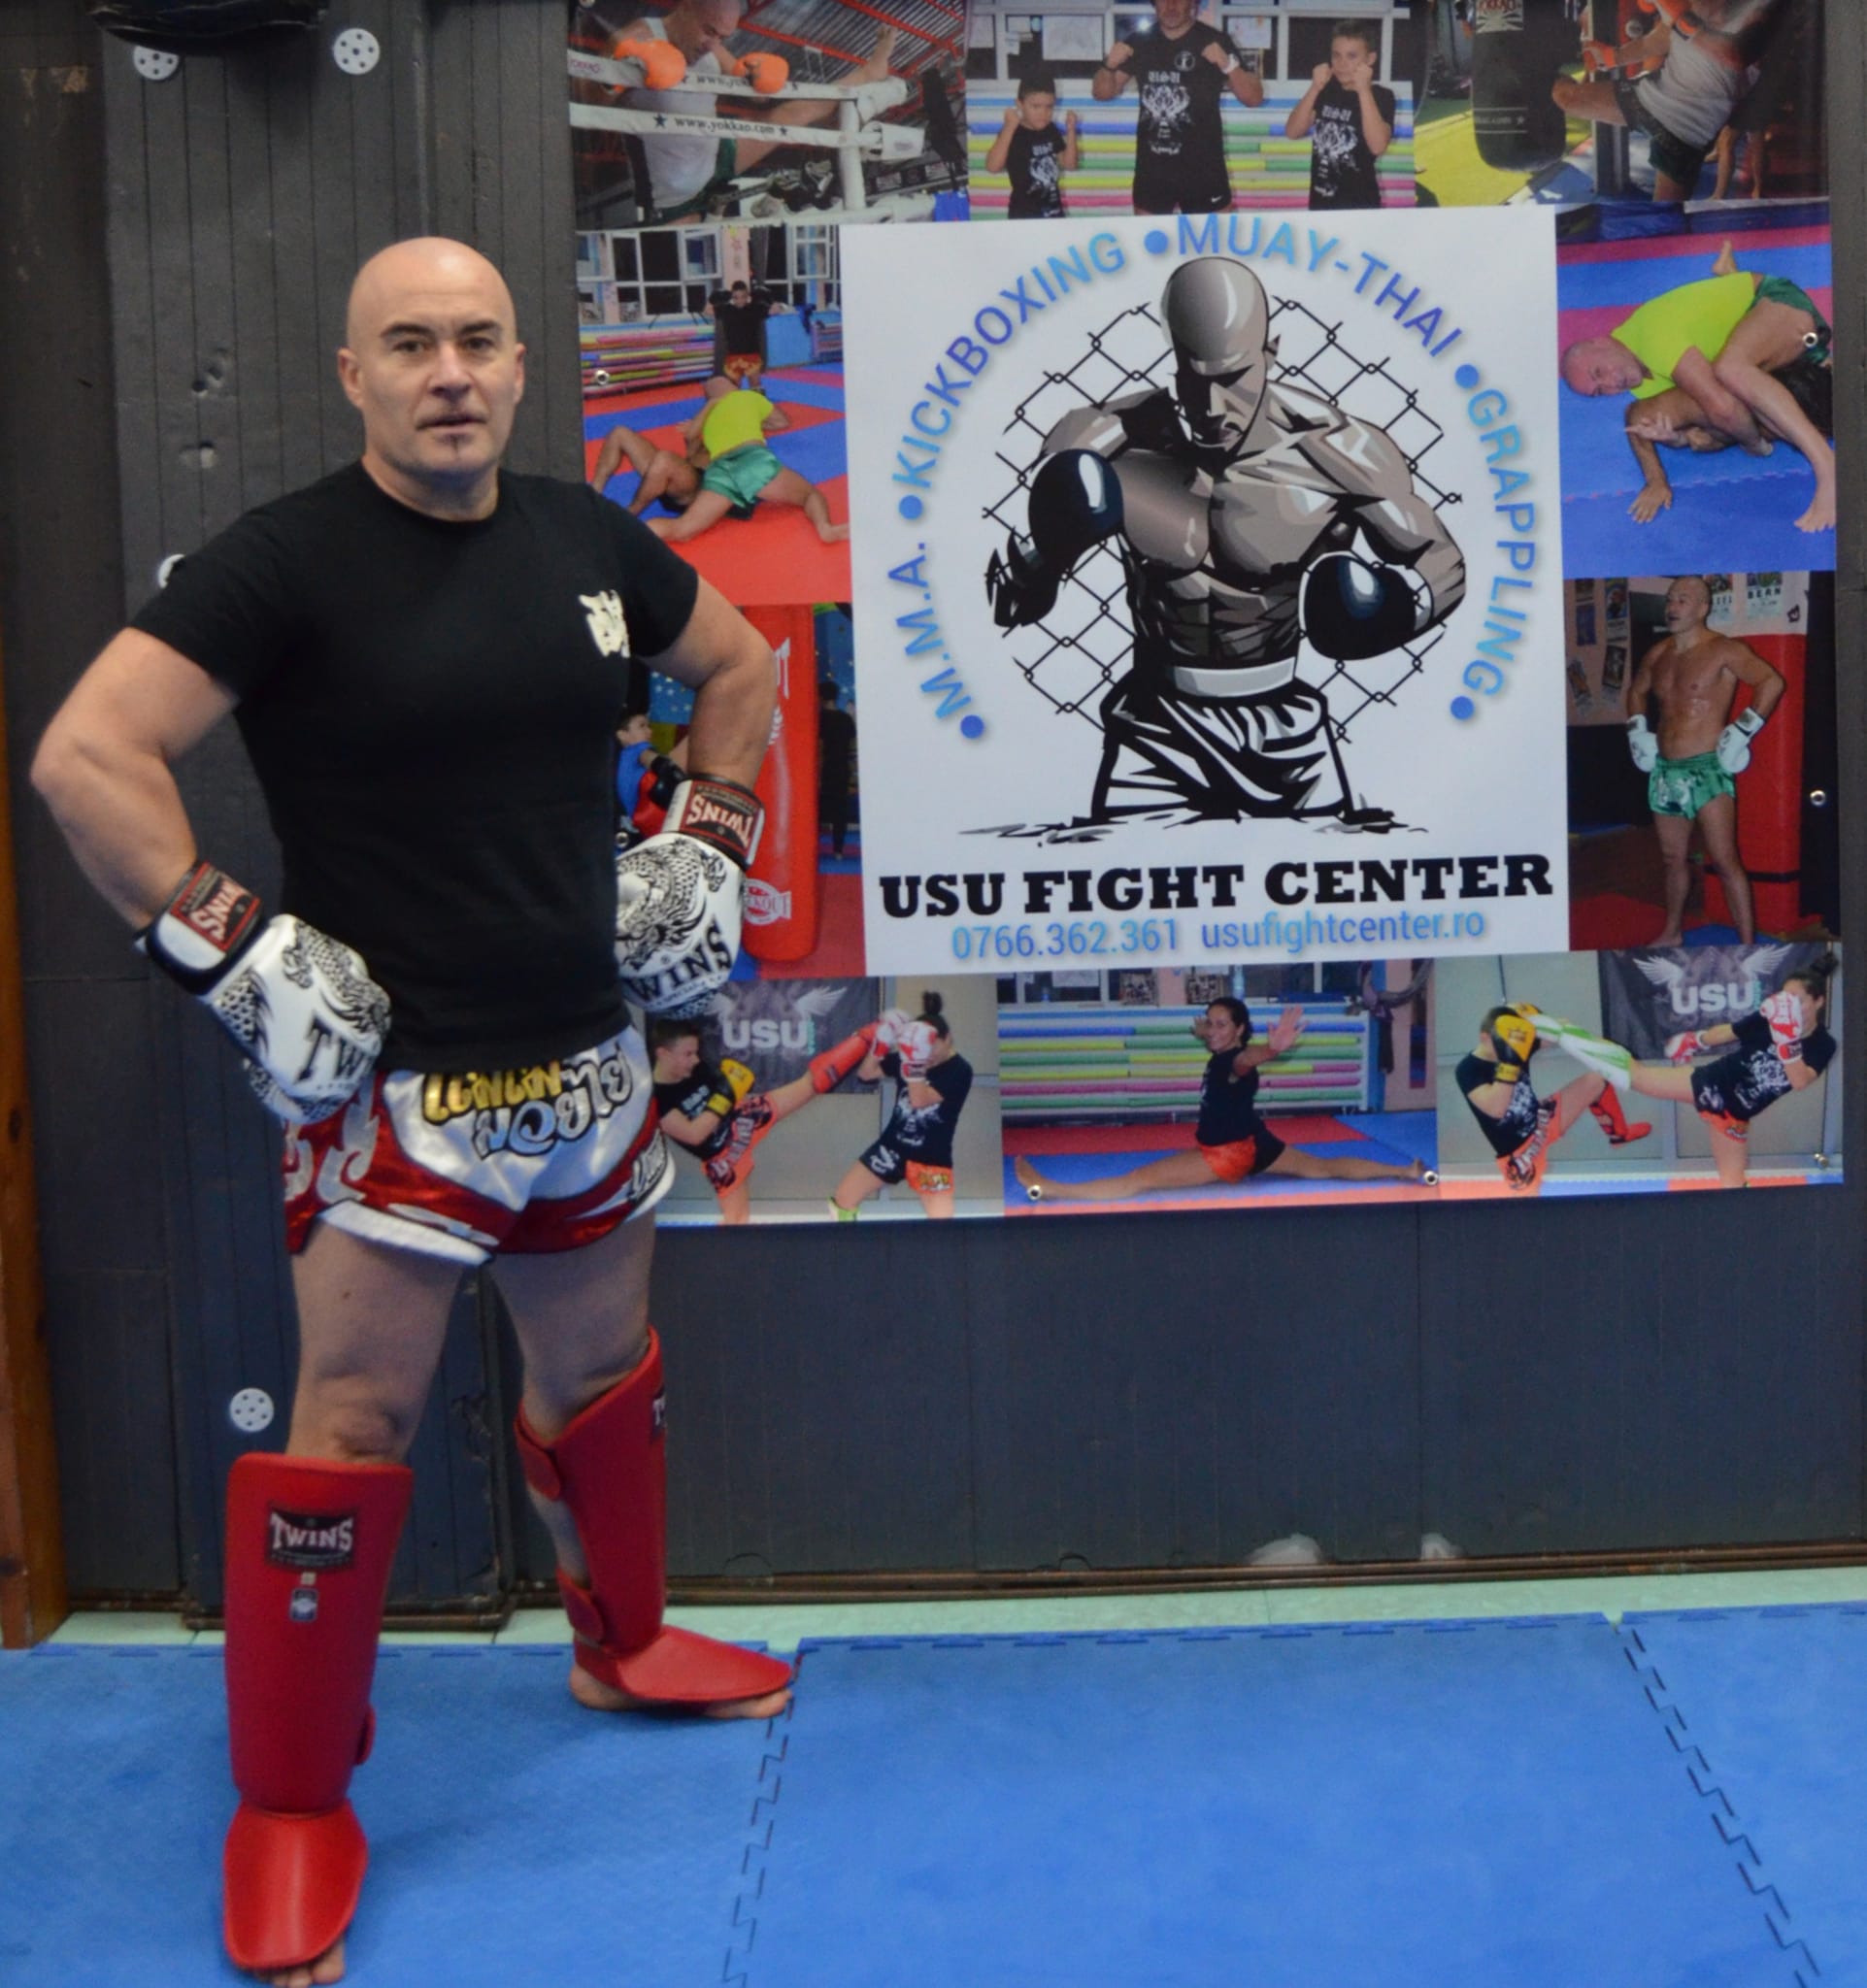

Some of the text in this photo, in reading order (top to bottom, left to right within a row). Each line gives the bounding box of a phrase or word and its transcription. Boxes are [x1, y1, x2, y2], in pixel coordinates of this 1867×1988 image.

[675, 116, 775, 133] www.yokkao.com
[1177, 213, 1462, 357] MUAY-THAI
[892, 232, 1126, 489] KICKBOXING
[1462, 388, 1536, 696] GRAPPLING
[887, 542, 972, 719] M.M.A.
[685, 793, 753, 848] TWINS
[879, 853, 1553, 918] USU FIGHT CENTER
[623, 914, 732, 1003] WINS
[951, 910, 1485, 959] 0766.362.361 usufightcenter.ro
[1671, 981, 1754, 1015] USU
[722, 1019, 808, 1049] USU
[270, 1511, 354, 1552] TWINS
